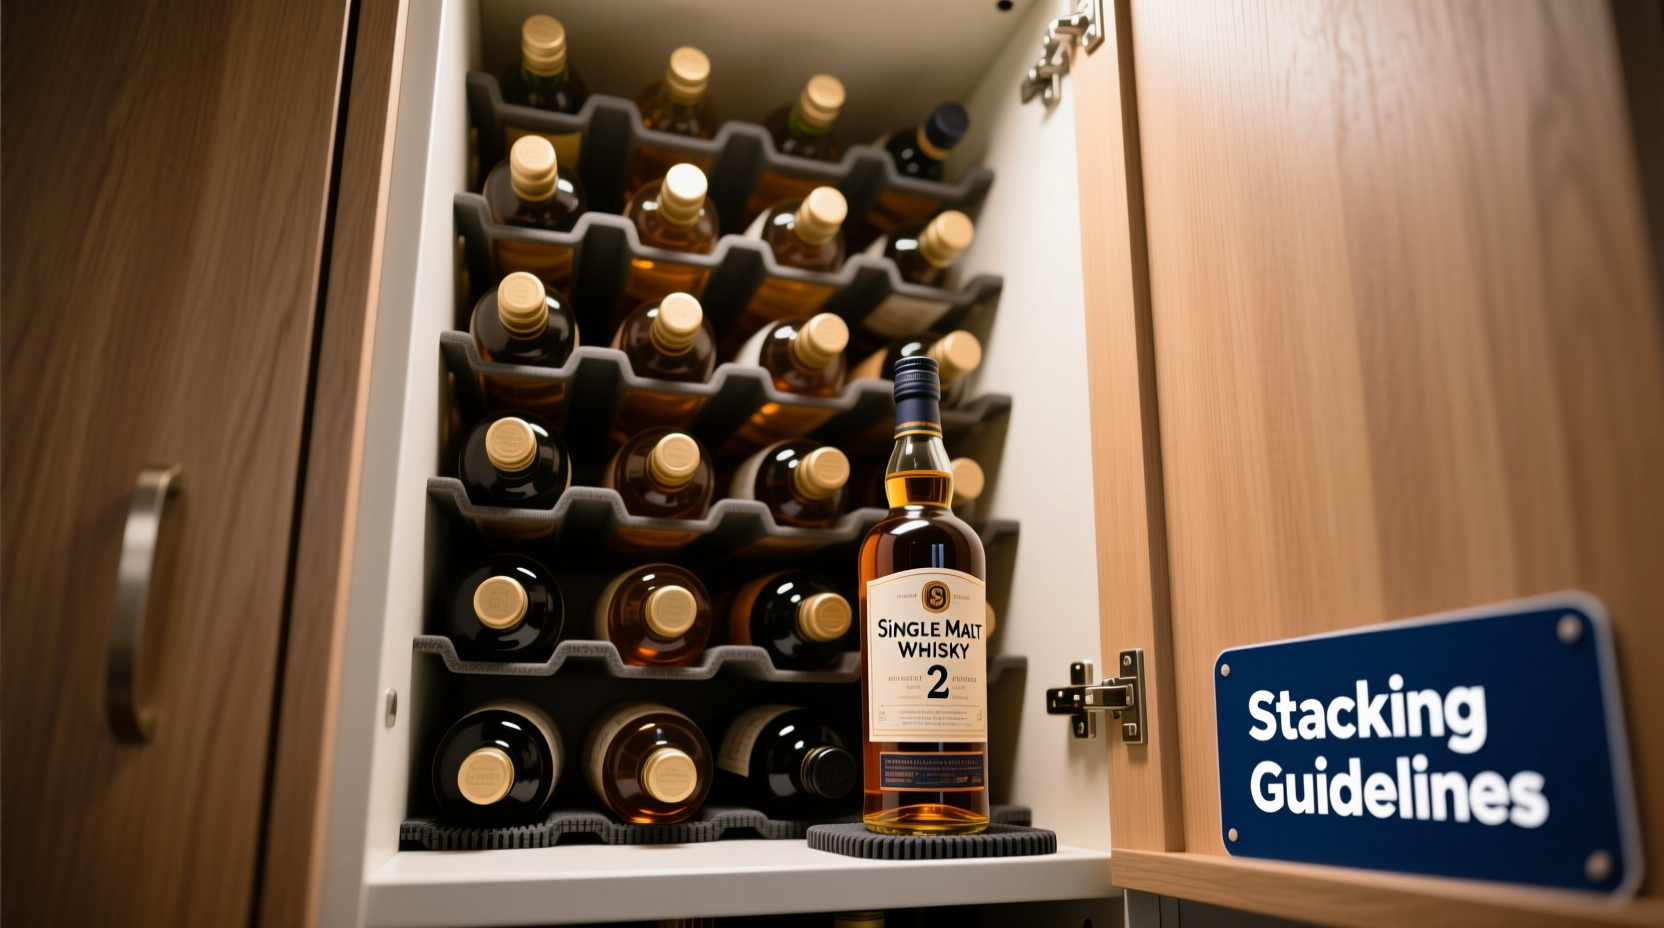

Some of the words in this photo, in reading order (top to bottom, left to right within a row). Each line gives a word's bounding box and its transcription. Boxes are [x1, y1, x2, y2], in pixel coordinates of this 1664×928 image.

[945, 619, 982, 639] MALT
[898, 641, 969, 659] WHISKY
[927, 664, 949, 698] 2
[1248, 673, 1487, 754] Stacking
[1250, 754, 1550, 829] Guidelines
